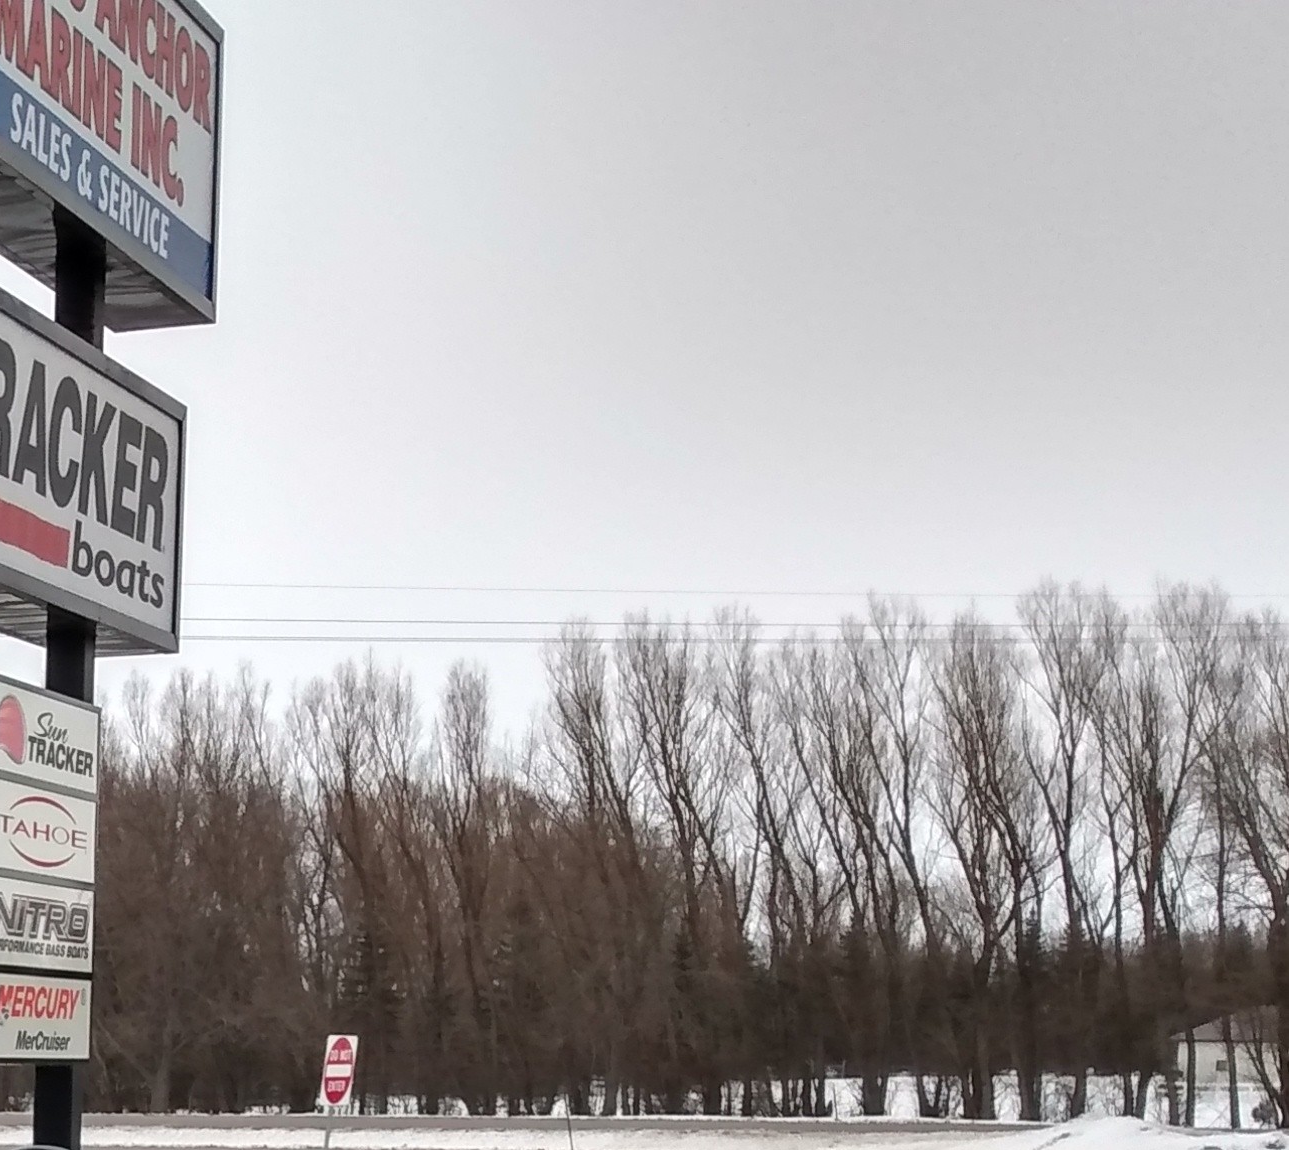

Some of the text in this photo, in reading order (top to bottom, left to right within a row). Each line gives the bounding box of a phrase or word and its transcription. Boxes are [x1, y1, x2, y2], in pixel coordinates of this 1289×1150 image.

[131, 81, 184, 207] INC.
[10, 92, 170, 260] SALES & SERVICE
[72, 519, 165, 610] boats
[34, 712, 69, 743] Sun
[28, 735, 94, 778] TRACKER
[45, 943, 66, 957] BASS
[66, 946, 89, 960] BOATS
[15, 1030, 71, 1051] MerCruiser
